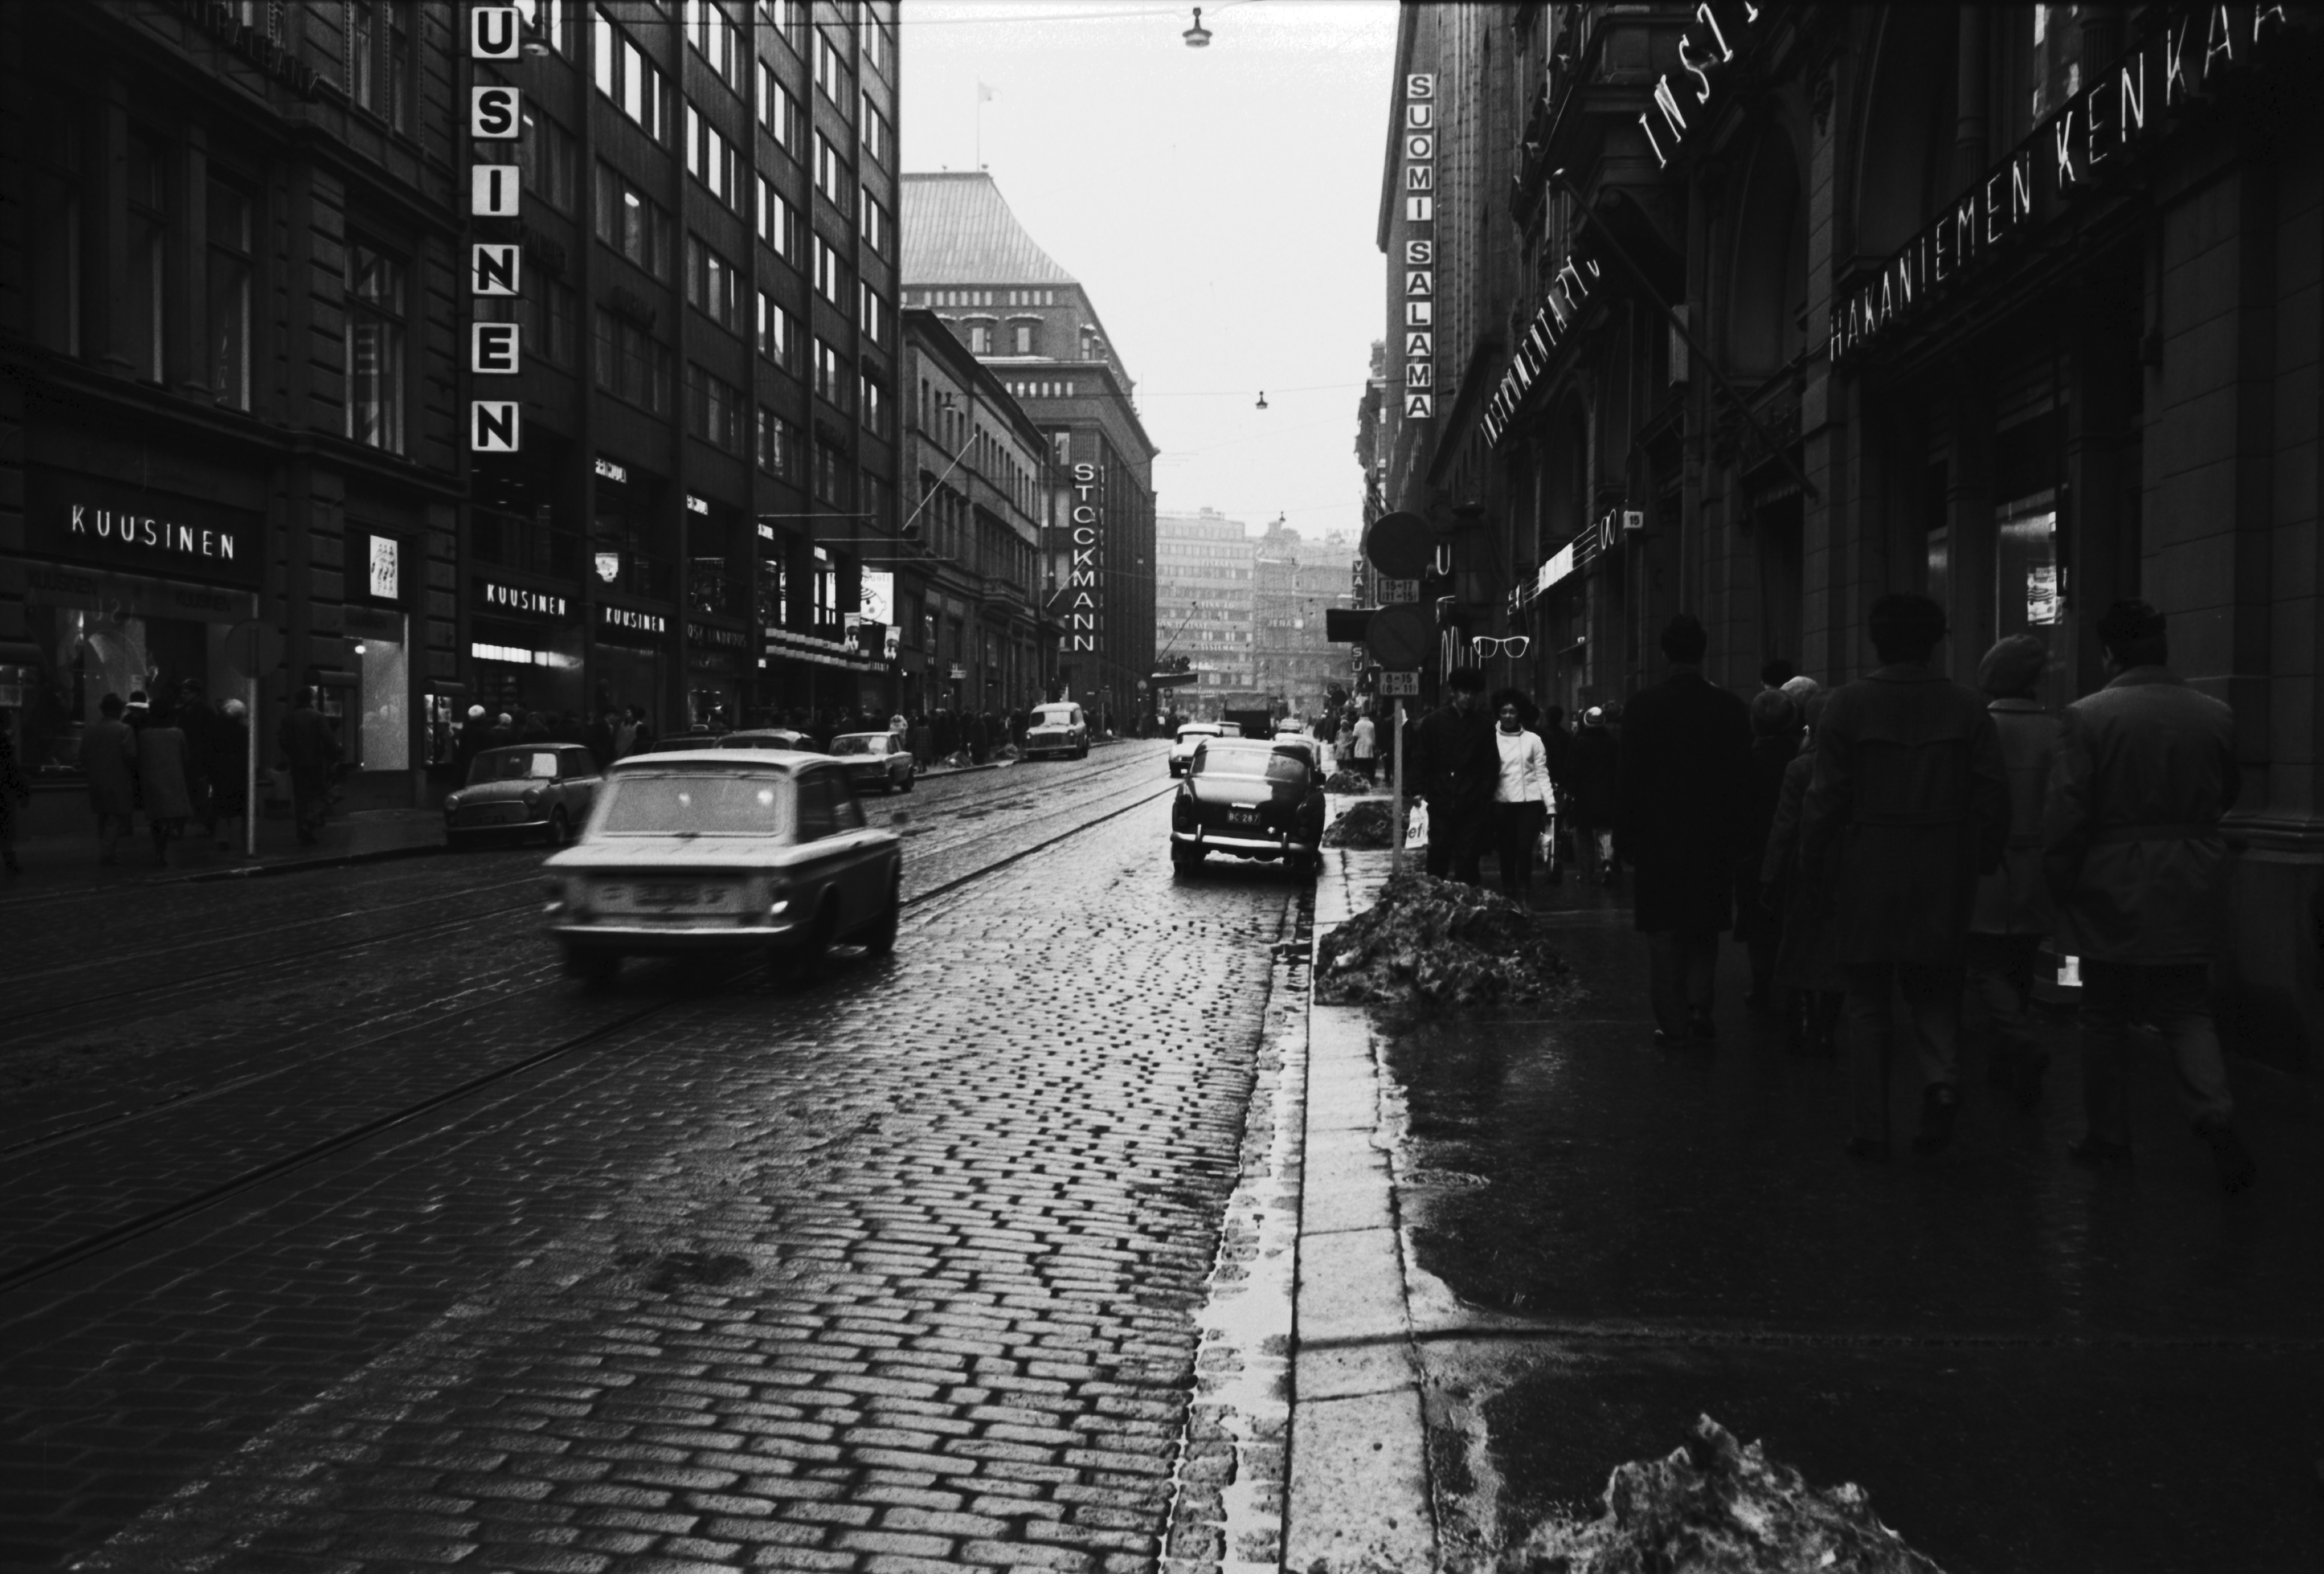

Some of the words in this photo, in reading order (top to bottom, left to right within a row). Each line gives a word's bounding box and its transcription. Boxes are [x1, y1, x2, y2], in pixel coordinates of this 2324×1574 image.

[1409, 76, 1431, 219] SUOMI
[1830, 150, 2030, 362] HAKANIEMEN
[1408, 242, 1431, 417] SALAMA
[71, 504, 235, 561] KUUSINEN
[1629, 515, 1640, 526] 15
[1074, 463, 1095, 652] STOCKMANN
[28, 571, 98, 595] KUUSINEN
[486, 583, 566, 617] KUUSINEN
[1386, 581, 1413, 591] 15-17
[605, 606, 666, 633] KUUSINEN
[1386, 673, 1413, 684] 8-15
